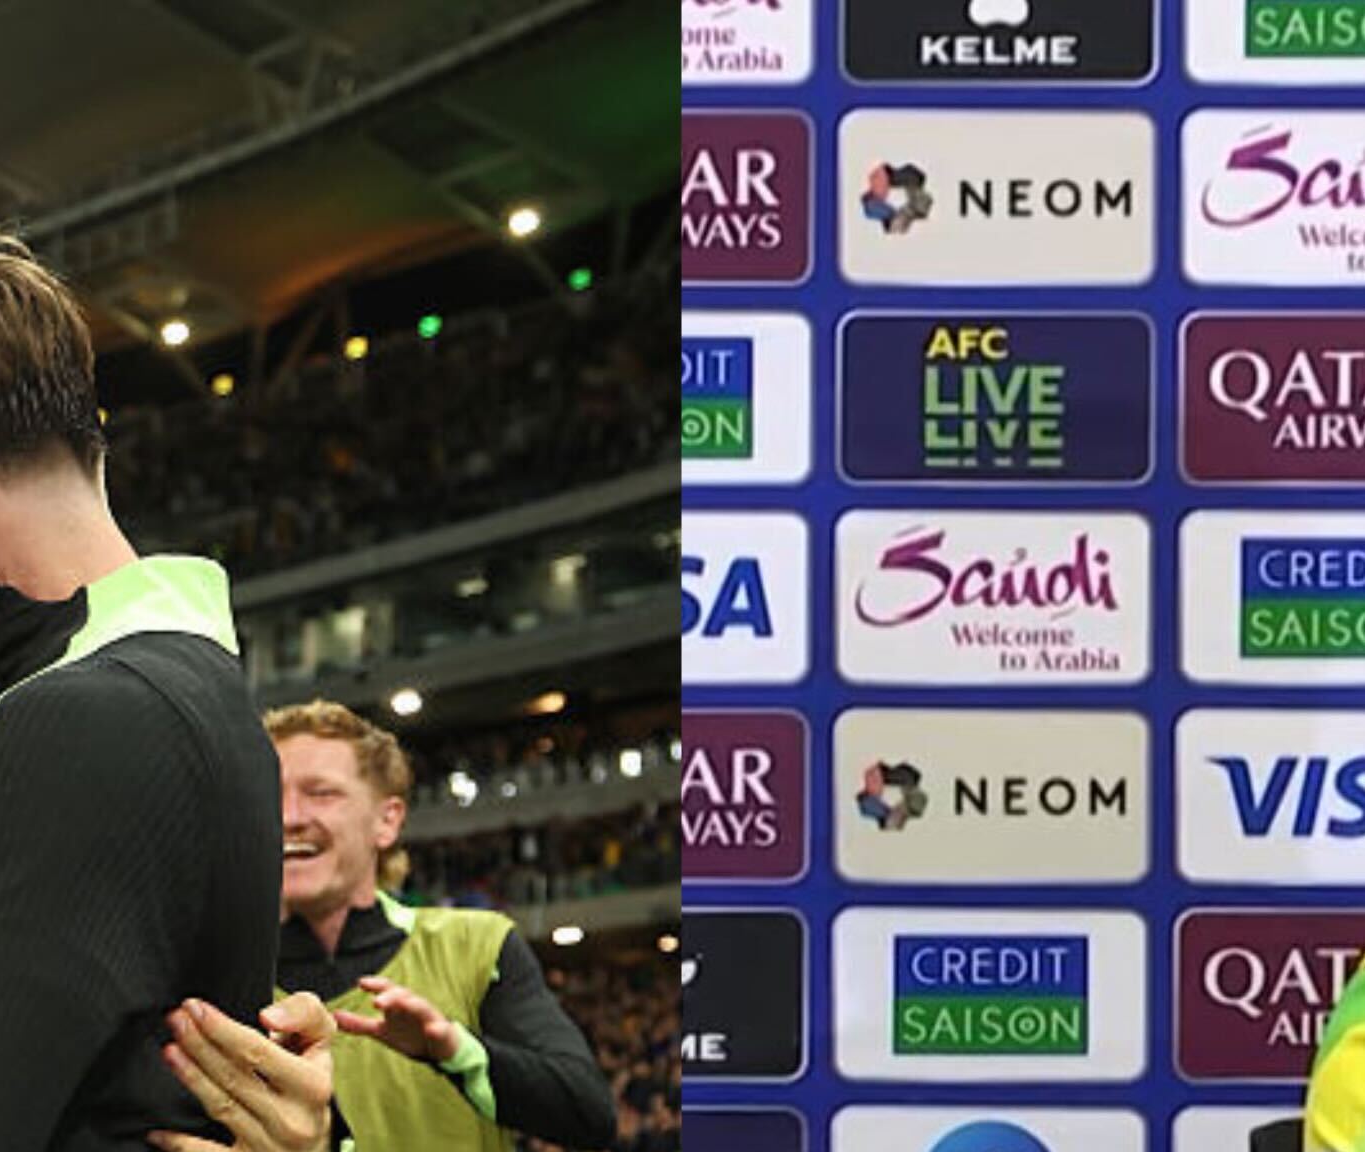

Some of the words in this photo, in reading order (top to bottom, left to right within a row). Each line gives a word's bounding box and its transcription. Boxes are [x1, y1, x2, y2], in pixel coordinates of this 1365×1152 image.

[697, 46, 783, 73] Arabia
[921, 36, 1078, 65] KELME
[959, 180, 1133, 217] NEOM
[926, 328, 1008, 359] AFC
[925, 366, 1064, 413] LIVE
[951, 623, 1074, 648] Welcome
[1000, 649, 1028, 672] to
[1033, 647, 1120, 673] Arabia
[955, 778, 1128, 816] NEOM
[912, 947, 1070, 985] CREDIT
[902, 1006, 1081, 1044] SAISON
